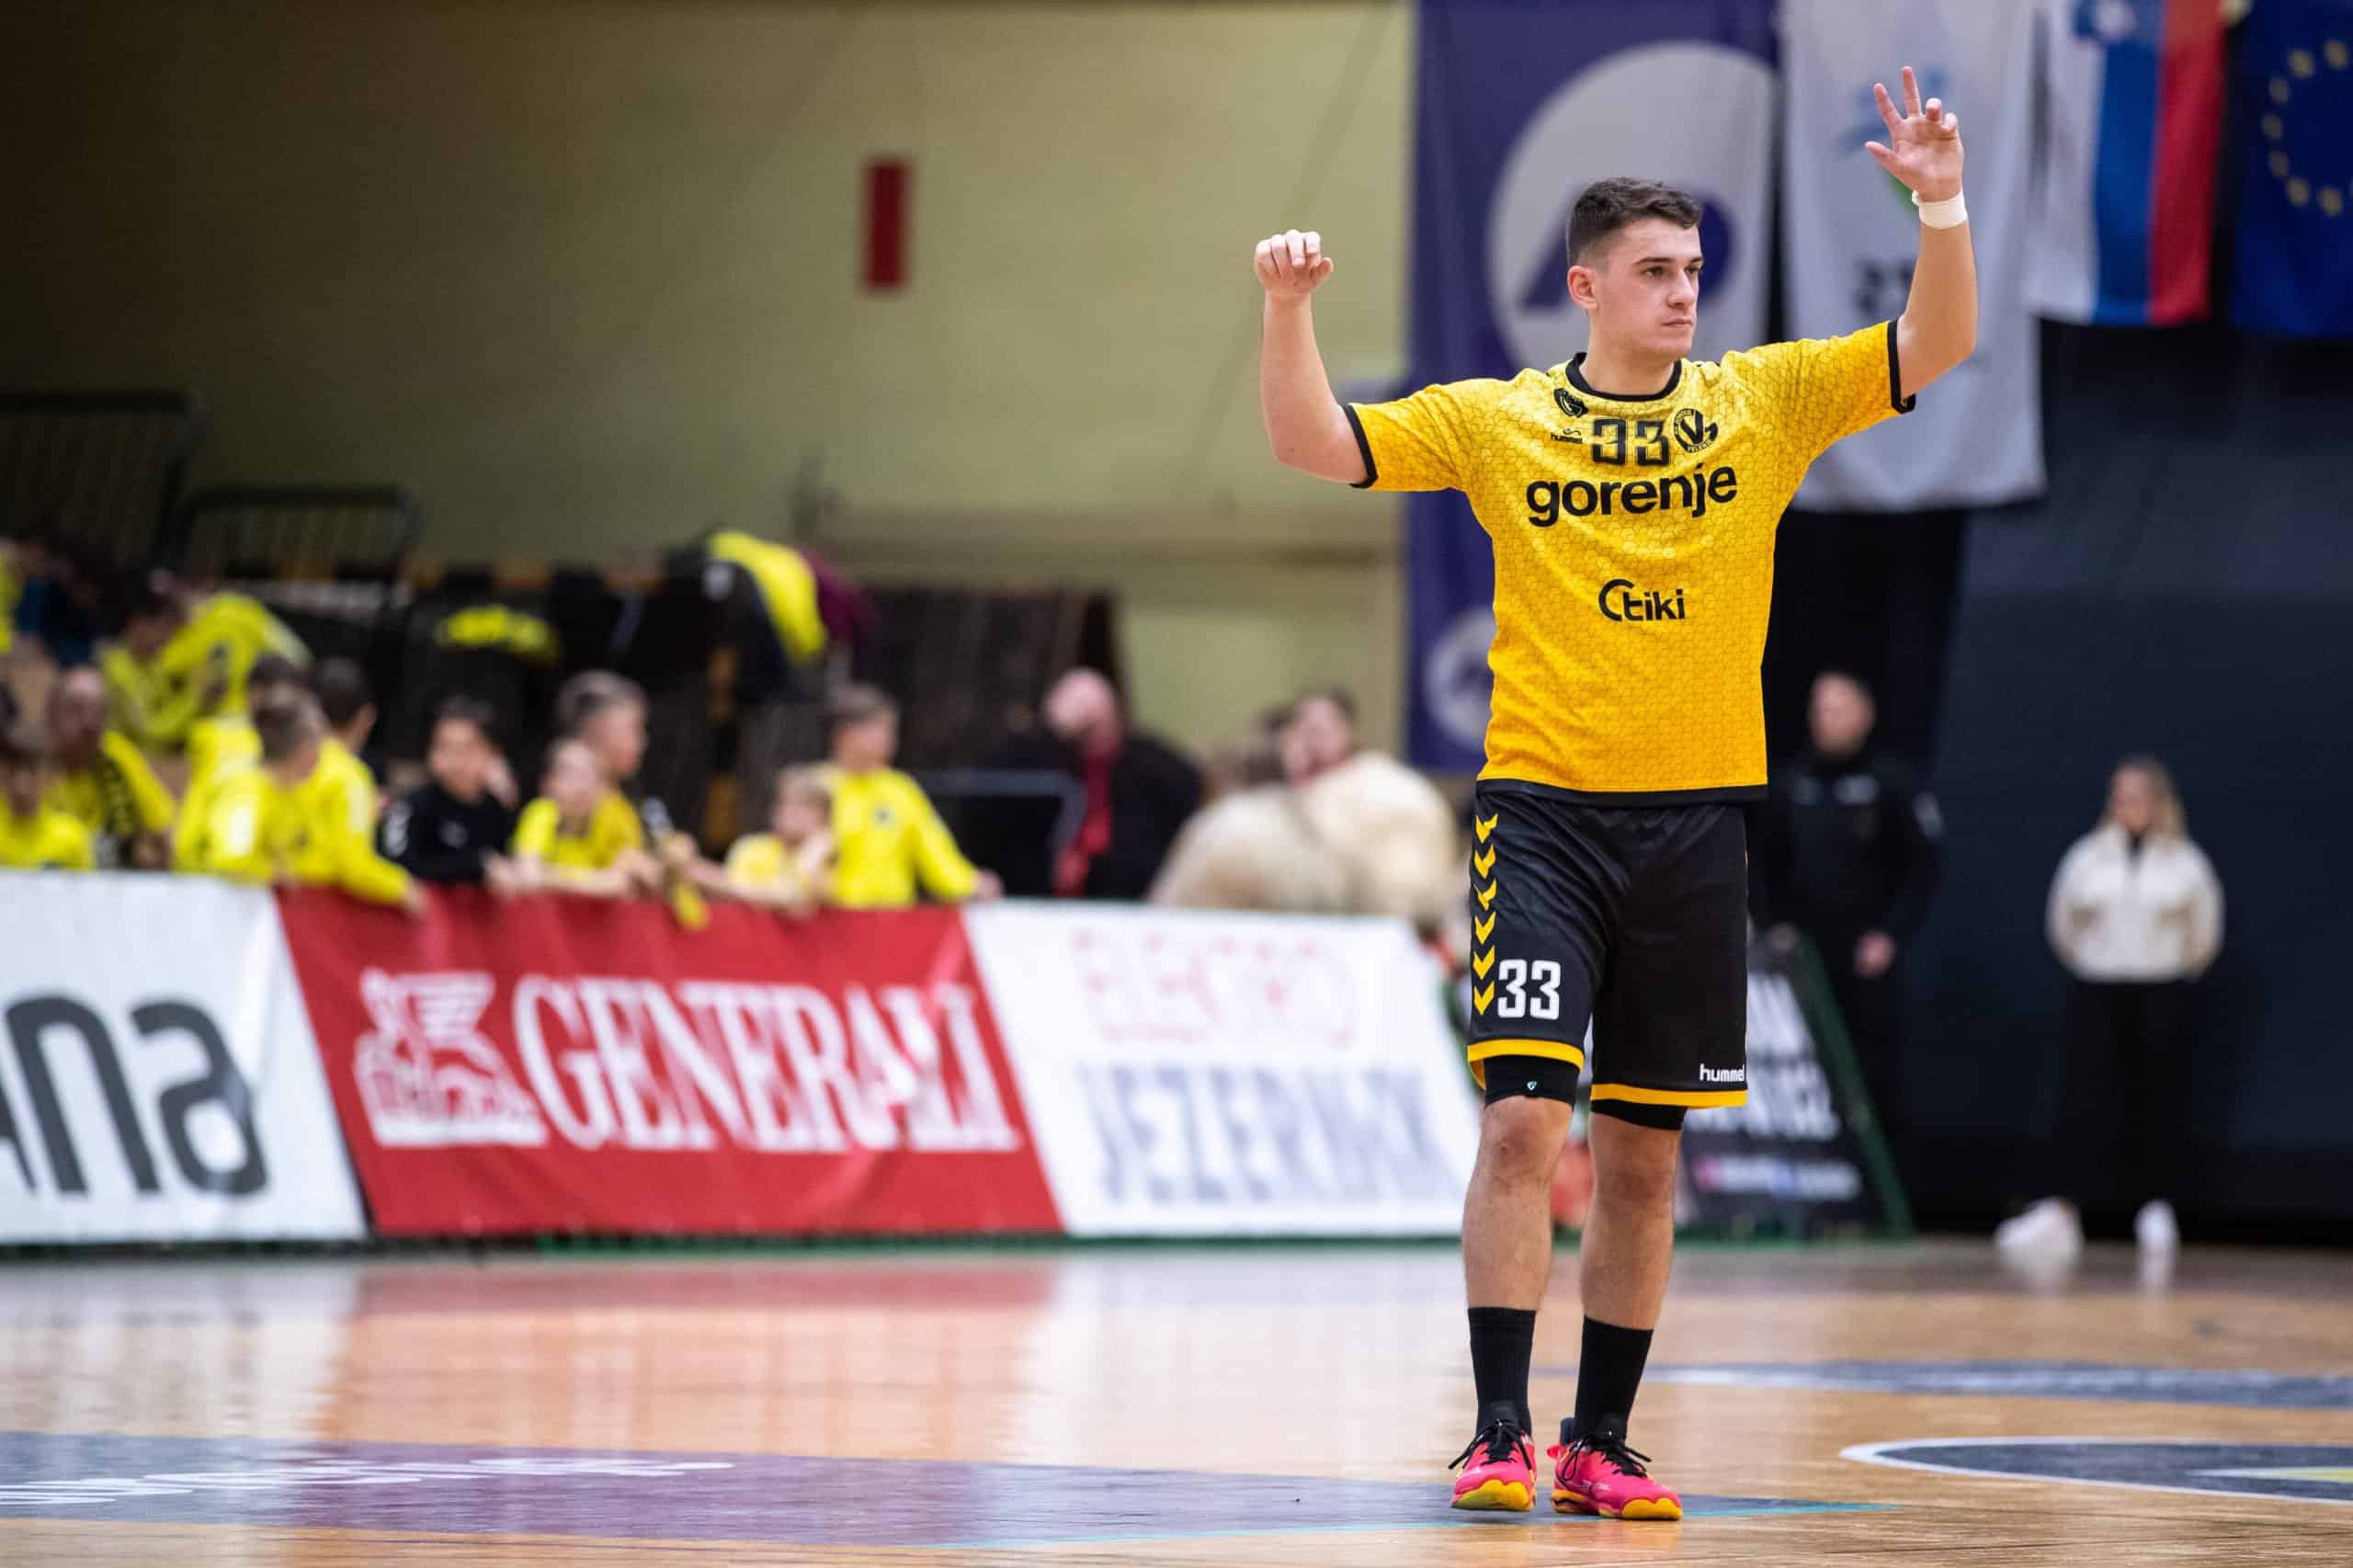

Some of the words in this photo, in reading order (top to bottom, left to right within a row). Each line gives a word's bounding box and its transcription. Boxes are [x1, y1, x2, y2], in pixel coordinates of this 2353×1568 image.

[1591, 417, 1669, 466] 33
[1526, 463, 1737, 528] gorenje
[1497, 959, 1561, 1020] 33
[512, 973, 1022, 1153] GENERALI
[0, 995, 269, 1198] na
